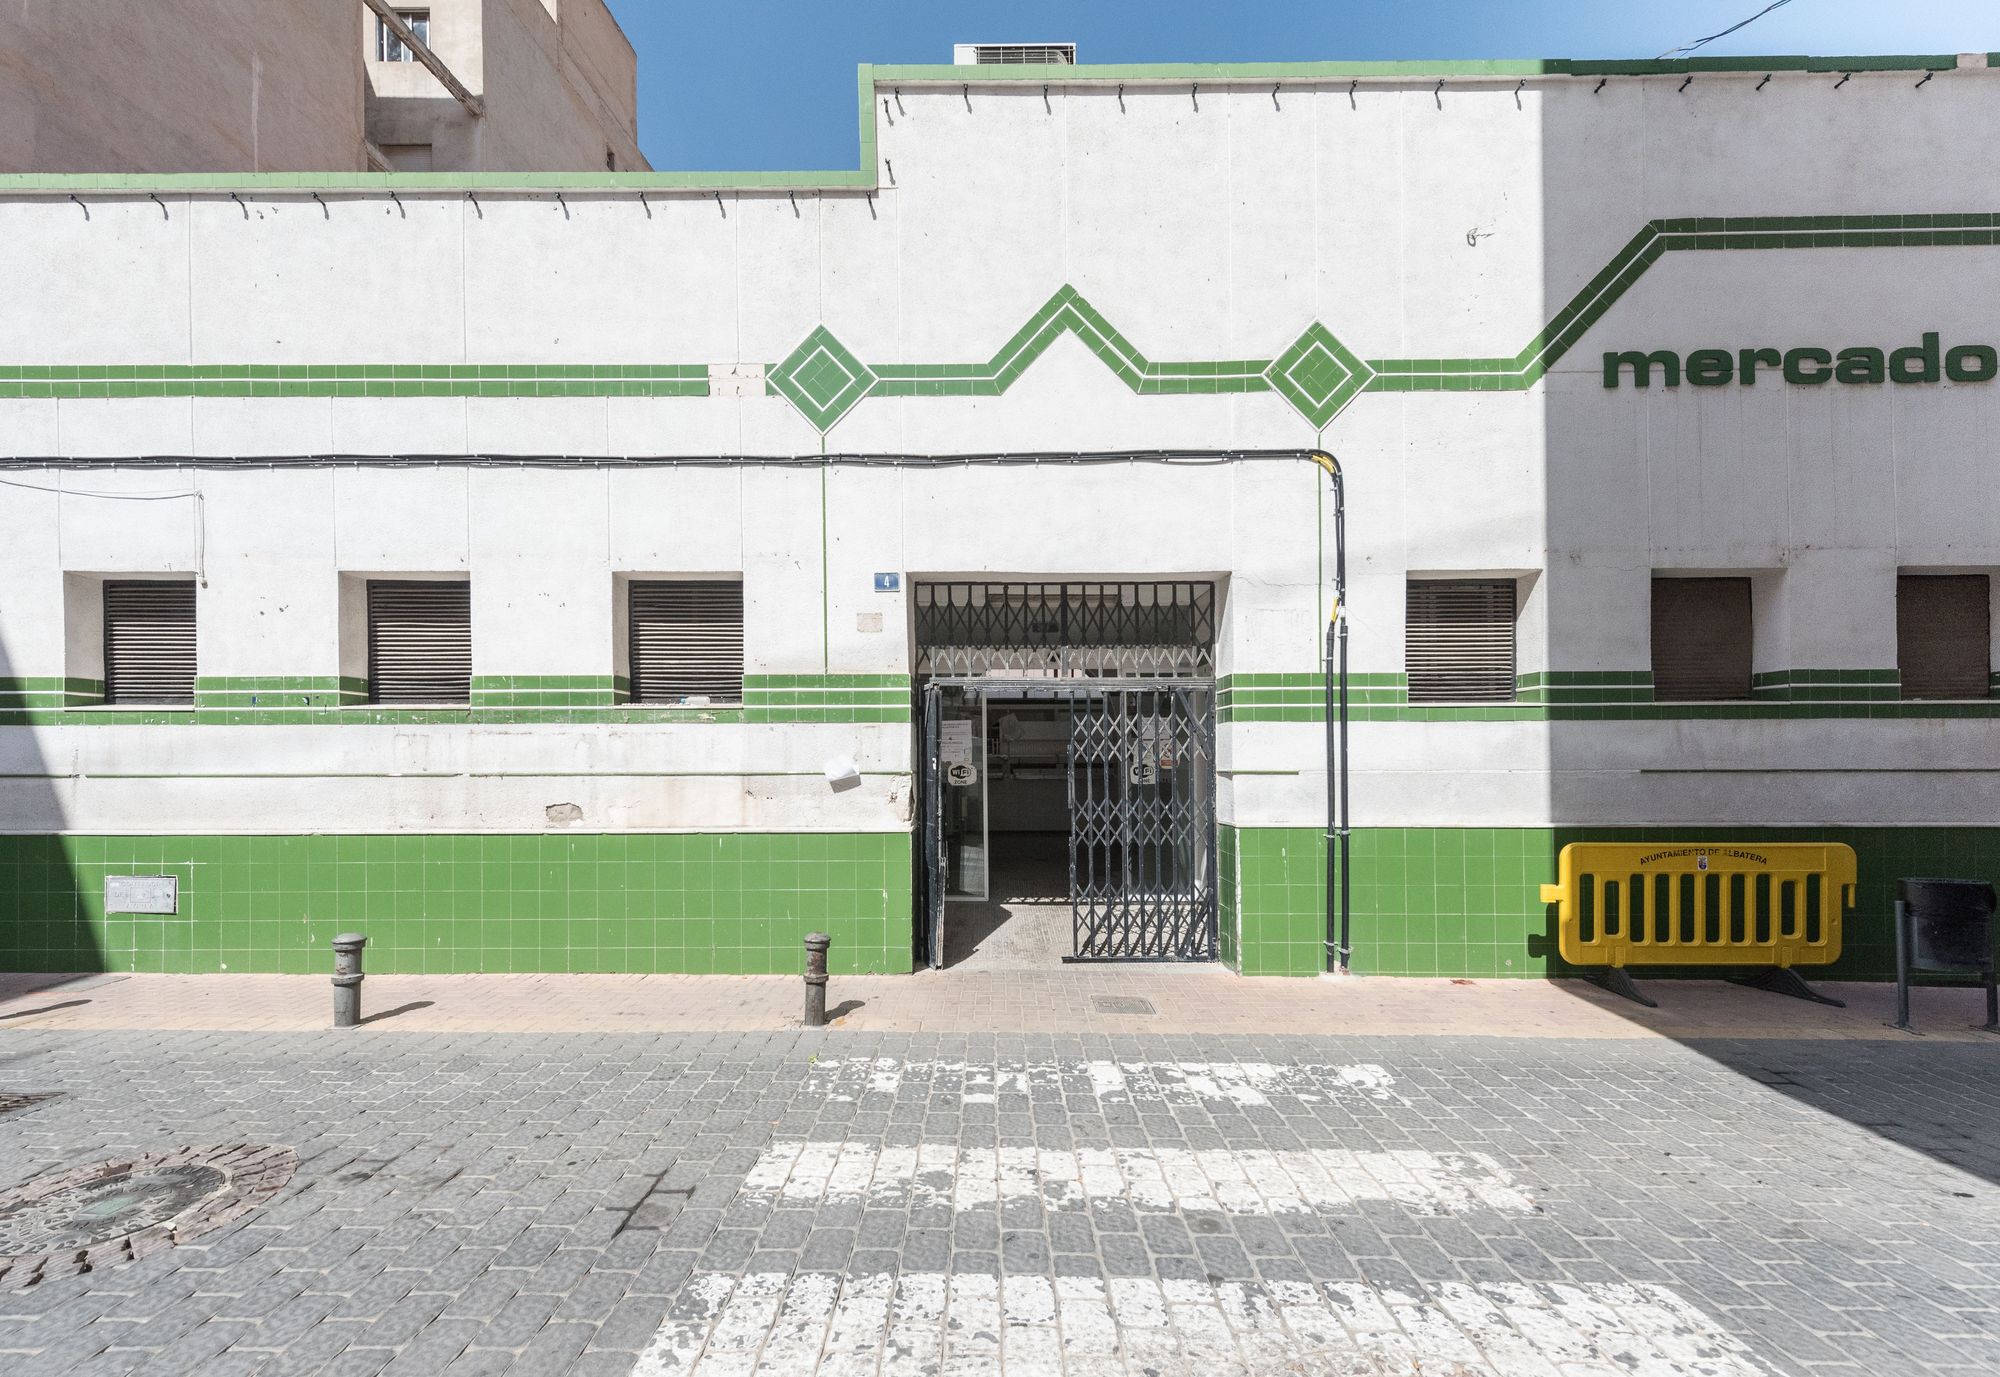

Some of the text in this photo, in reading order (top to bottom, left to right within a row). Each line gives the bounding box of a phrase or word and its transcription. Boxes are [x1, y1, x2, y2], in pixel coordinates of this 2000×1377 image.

[1603, 331, 1998, 388] mercado
[884, 575, 890, 588] 4
[1640, 848, 1706, 865] AYUNTAMIENTO
[1708, 848, 1720, 856] DE
